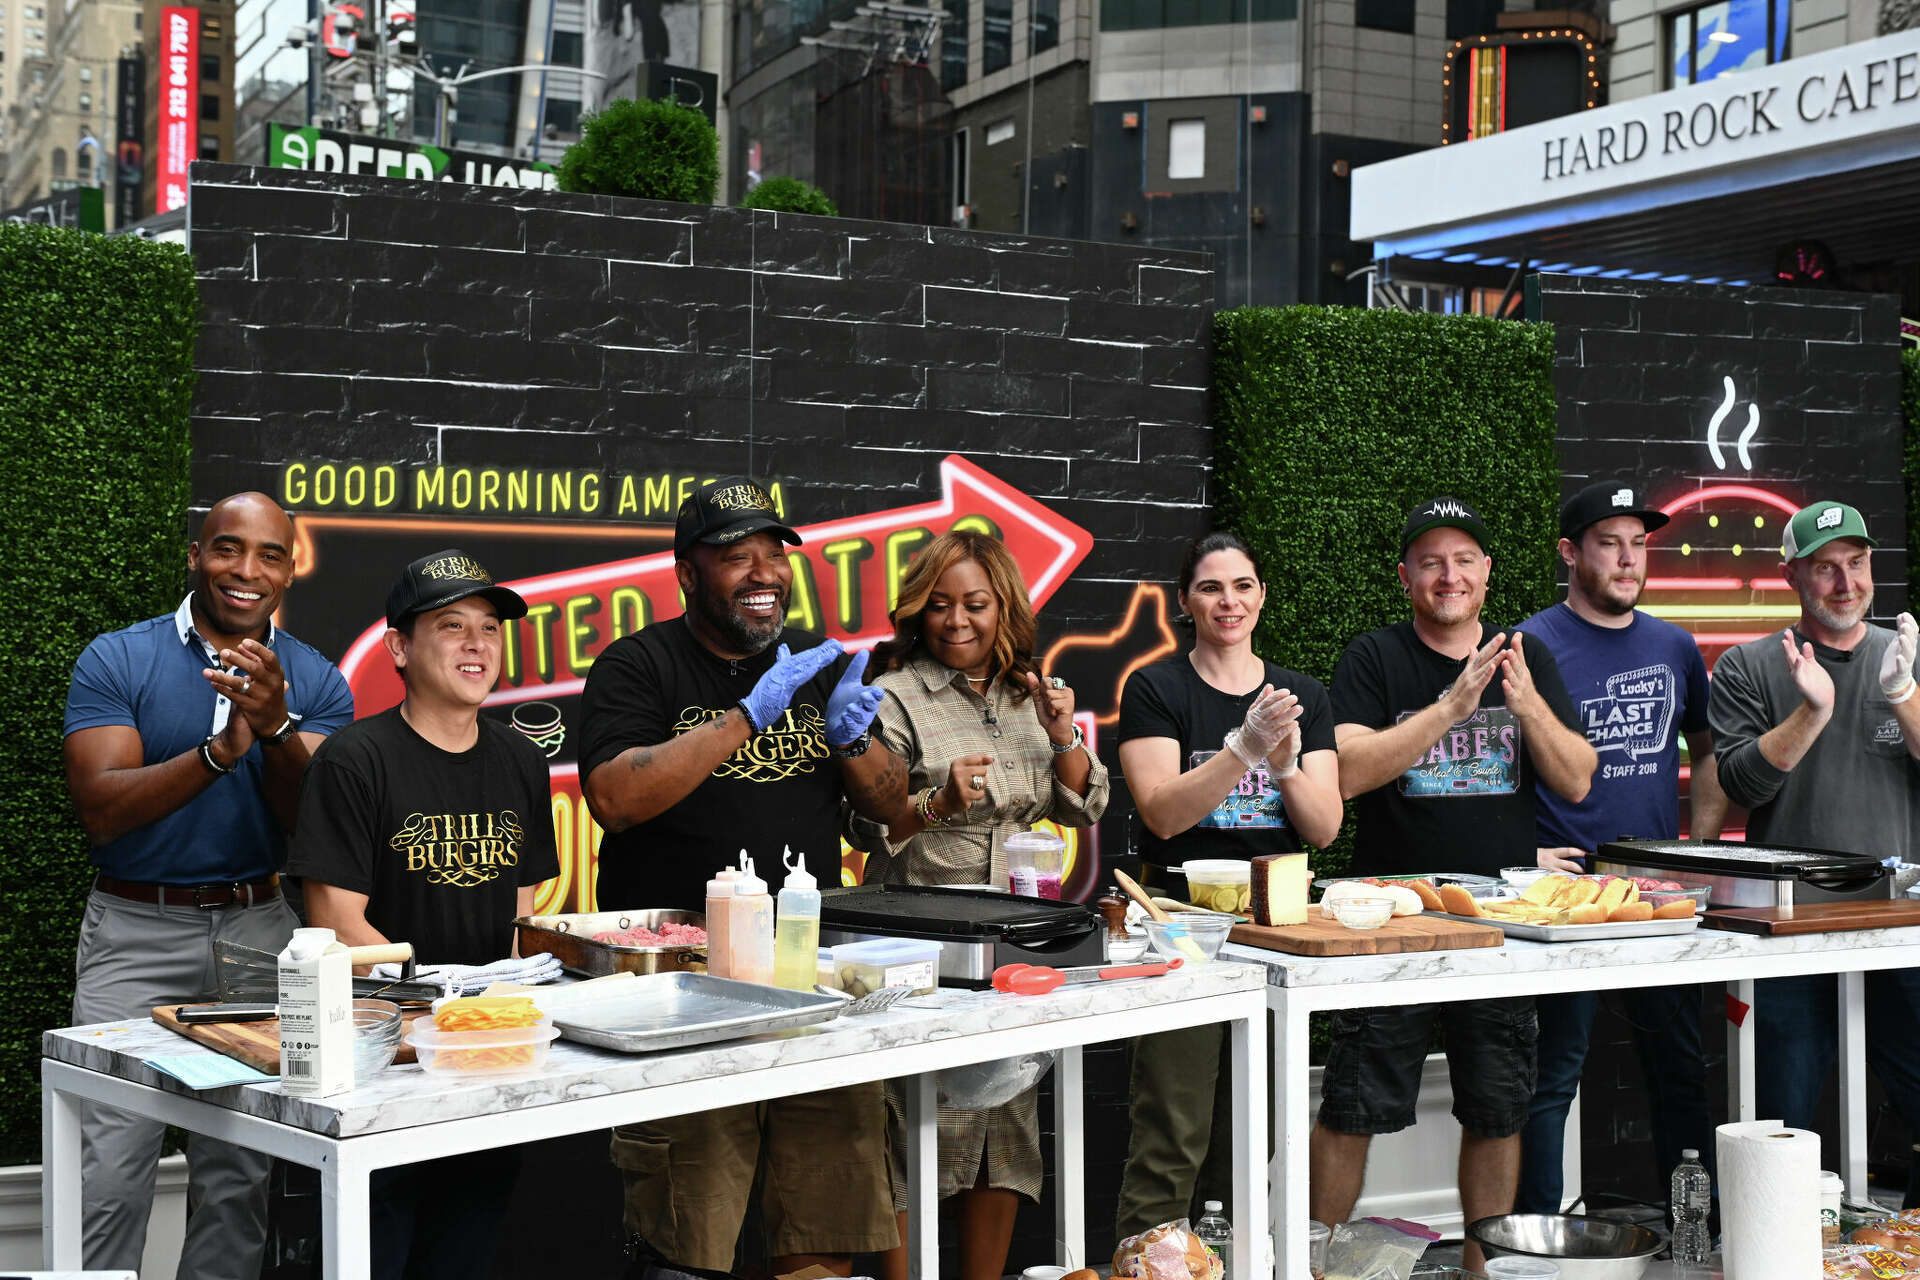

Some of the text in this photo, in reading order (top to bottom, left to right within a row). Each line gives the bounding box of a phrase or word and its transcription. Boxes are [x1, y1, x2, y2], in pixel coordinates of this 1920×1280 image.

[1542, 52, 1920, 180] HARD ROCK CAFE
[285, 464, 395, 508] GOOD
[416, 467, 600, 513] MORNING
[502, 586, 650, 682] ITED
[1620, 677, 1664, 697] Lucky's
[1588, 701, 1656, 729] LAST
[1586, 721, 1654, 743] CHANCE
[1601, 762, 1658, 779] STAFF 2018
[421, 812, 506, 842] TRILL
